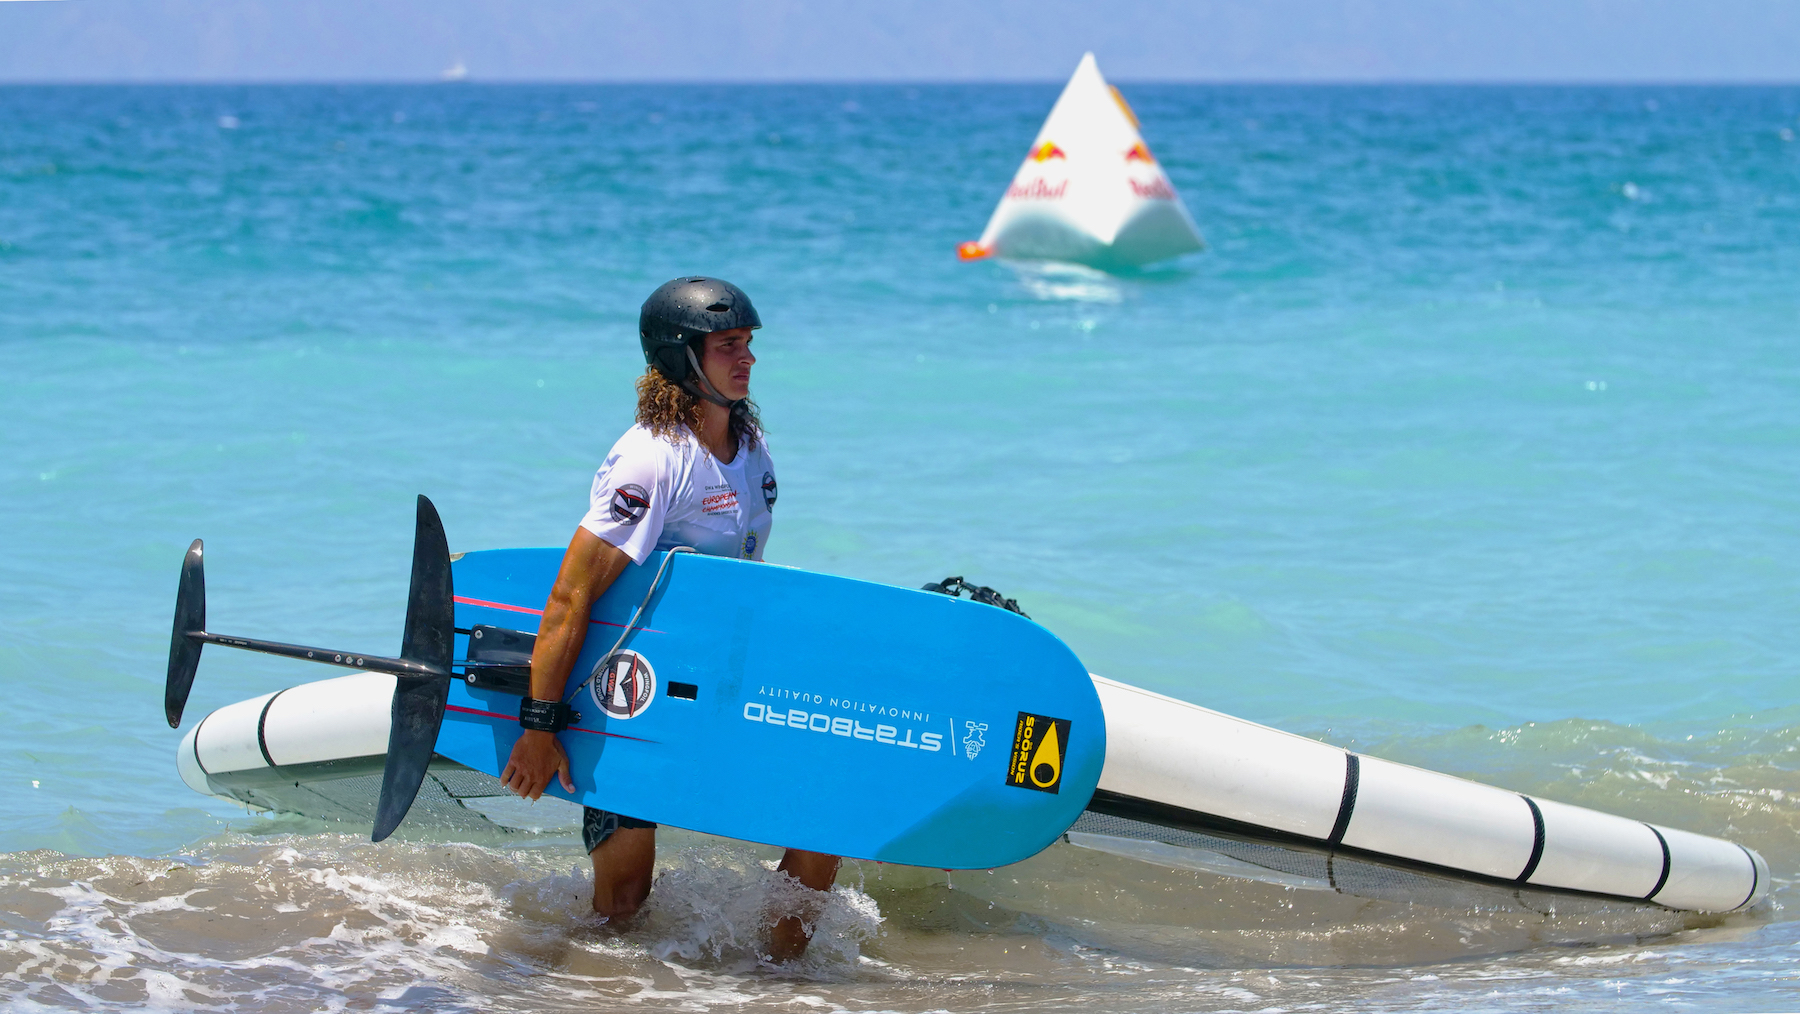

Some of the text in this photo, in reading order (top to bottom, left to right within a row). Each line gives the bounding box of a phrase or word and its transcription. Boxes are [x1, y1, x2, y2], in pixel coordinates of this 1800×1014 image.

[702, 490, 739, 505] EUROPEAN
[607, 672, 616, 692] GWA
[596, 684, 605, 701] TOUR
[759, 685, 930, 723] INNOVATION QUALITY
[1010, 751, 1019, 776] VISION
